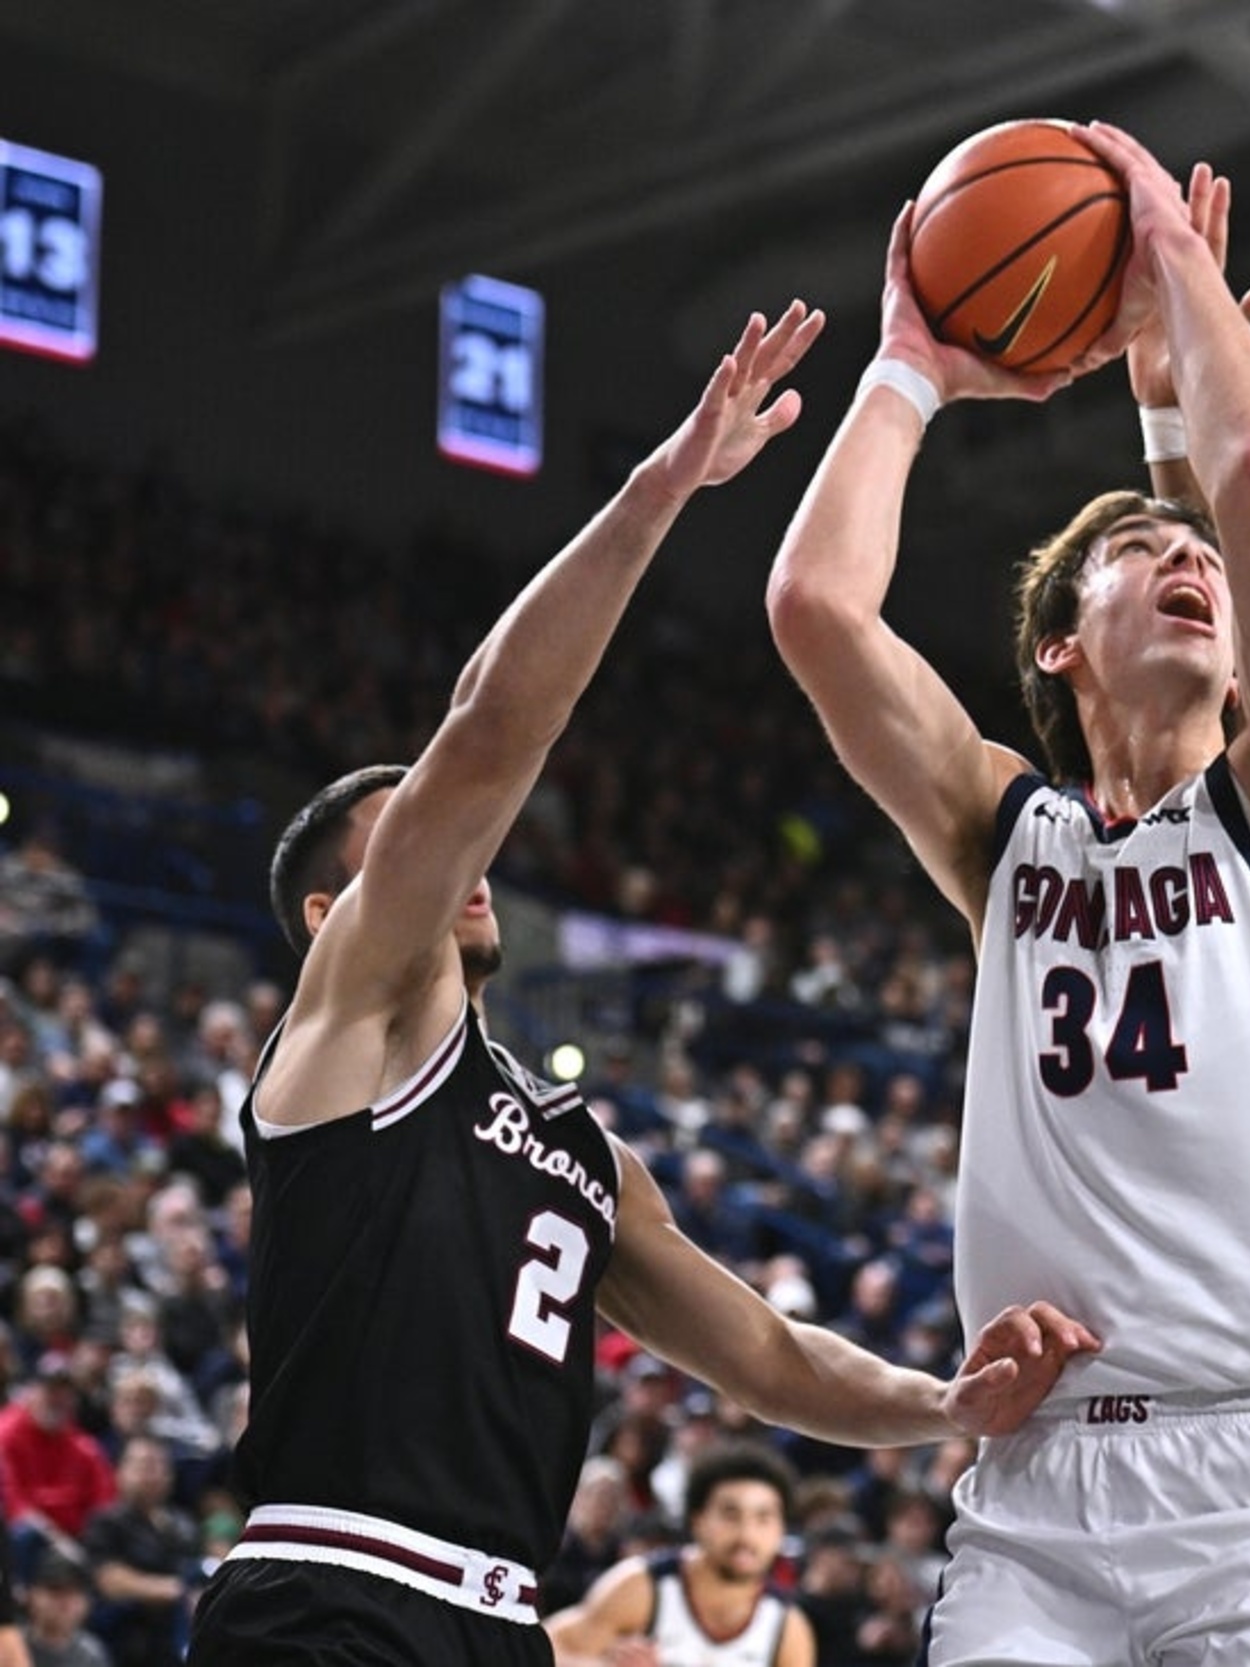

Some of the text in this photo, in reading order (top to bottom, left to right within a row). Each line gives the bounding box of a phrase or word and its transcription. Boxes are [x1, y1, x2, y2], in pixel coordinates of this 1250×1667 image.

[0, 206, 88, 292] 13
[450, 331, 534, 412] 21
[1013, 851, 1235, 951] GONAGA
[1038, 959, 1188, 1098] 34
[473, 1091, 617, 1243] Bronco
[508, 1208, 591, 1364] 2
